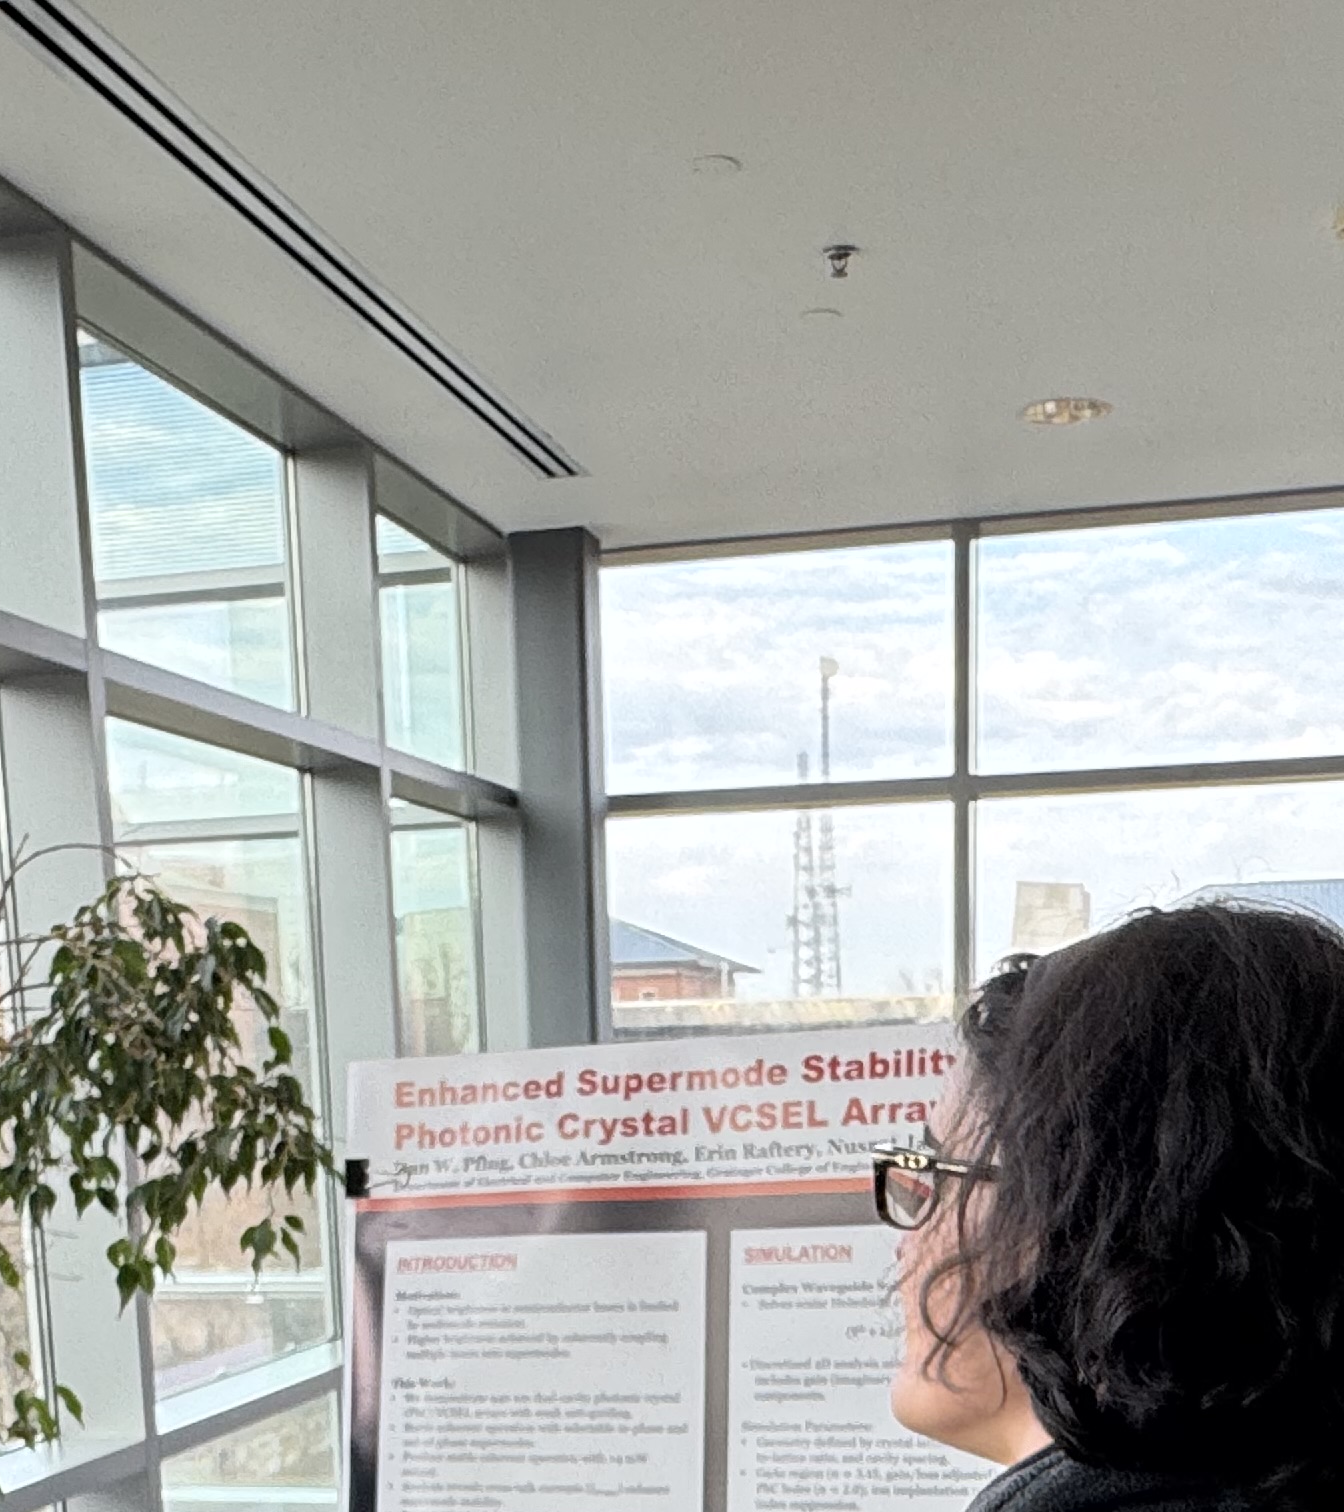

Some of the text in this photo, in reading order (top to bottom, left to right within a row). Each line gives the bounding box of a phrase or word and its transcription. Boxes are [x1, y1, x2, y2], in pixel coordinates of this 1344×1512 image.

[395, 1070, 565, 1109] Enhanced
[577, 1057, 788, 1101] Supermode
[394, 1096, 937, 1150] Photonic Crystal VCSEL Arra
[579, 1149, 690, 1168] Armstrong,
[694, 1144, 738, 1162] Erin
[742, 1140, 822, 1160] Raftery,
[743, 1244, 853, 1264] SIMULATION
